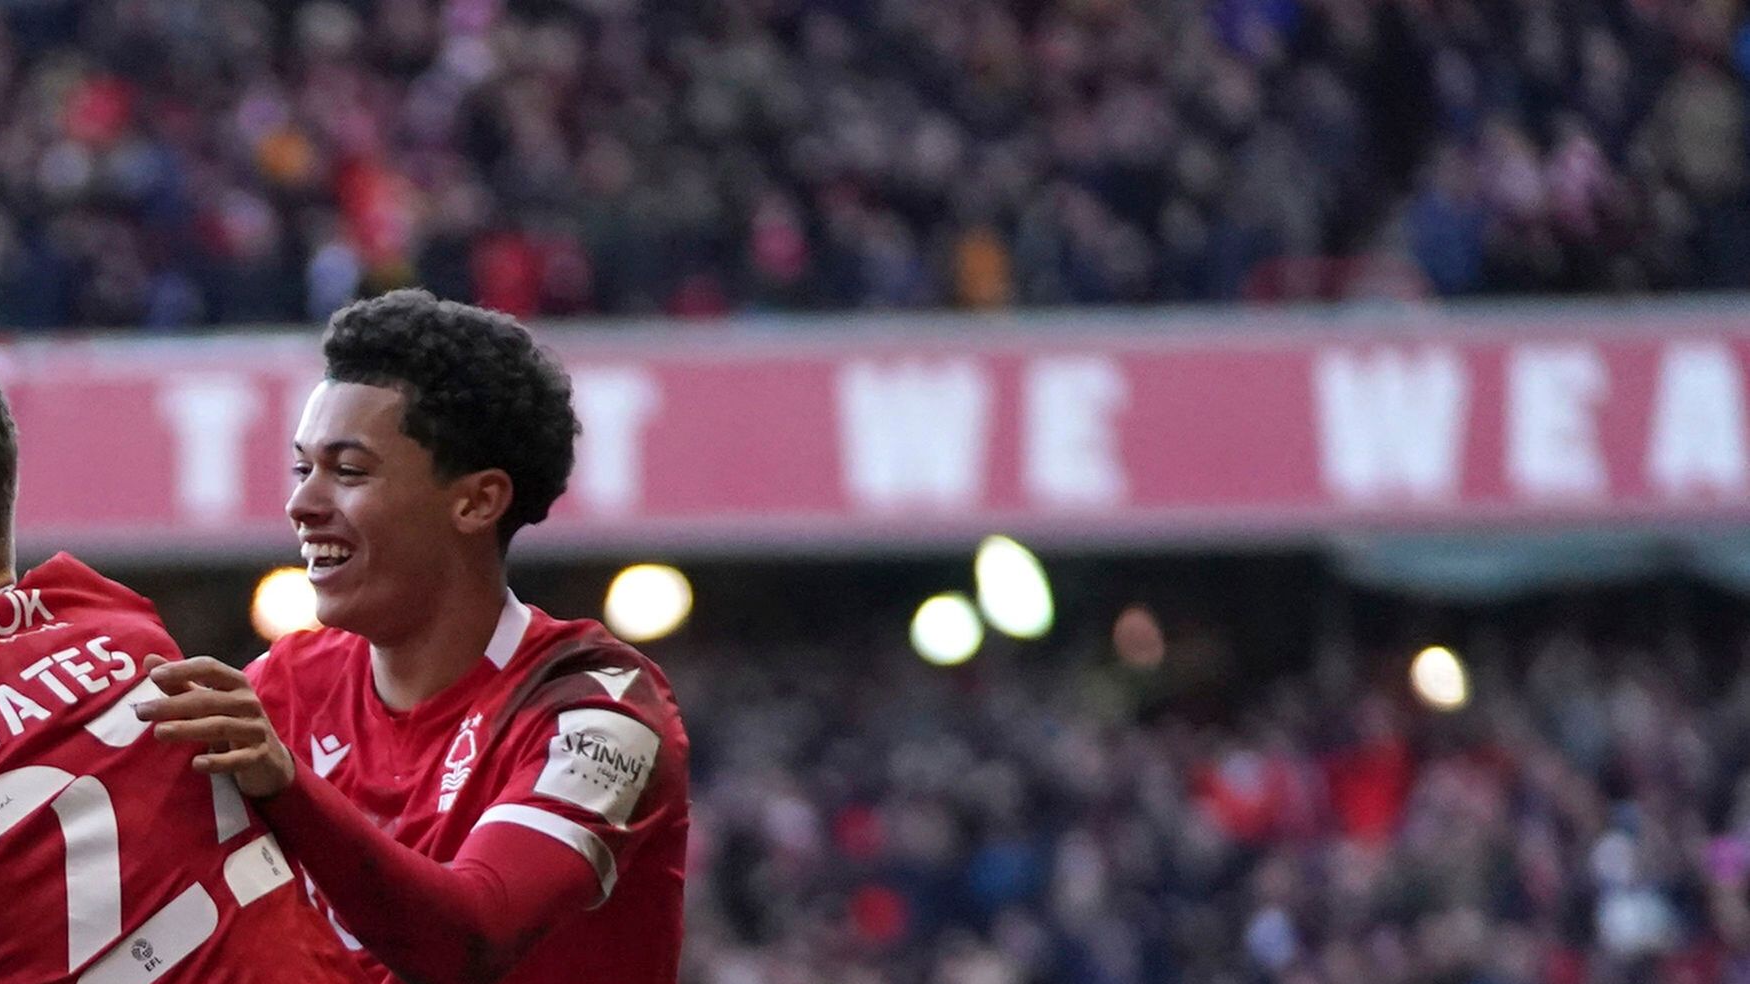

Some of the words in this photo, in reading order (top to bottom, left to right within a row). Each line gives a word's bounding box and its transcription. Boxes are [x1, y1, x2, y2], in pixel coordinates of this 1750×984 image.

[833, 357, 1128, 514] WE
[561, 732, 643, 784] SKINNY
[144, 956, 163, 972] EFL
